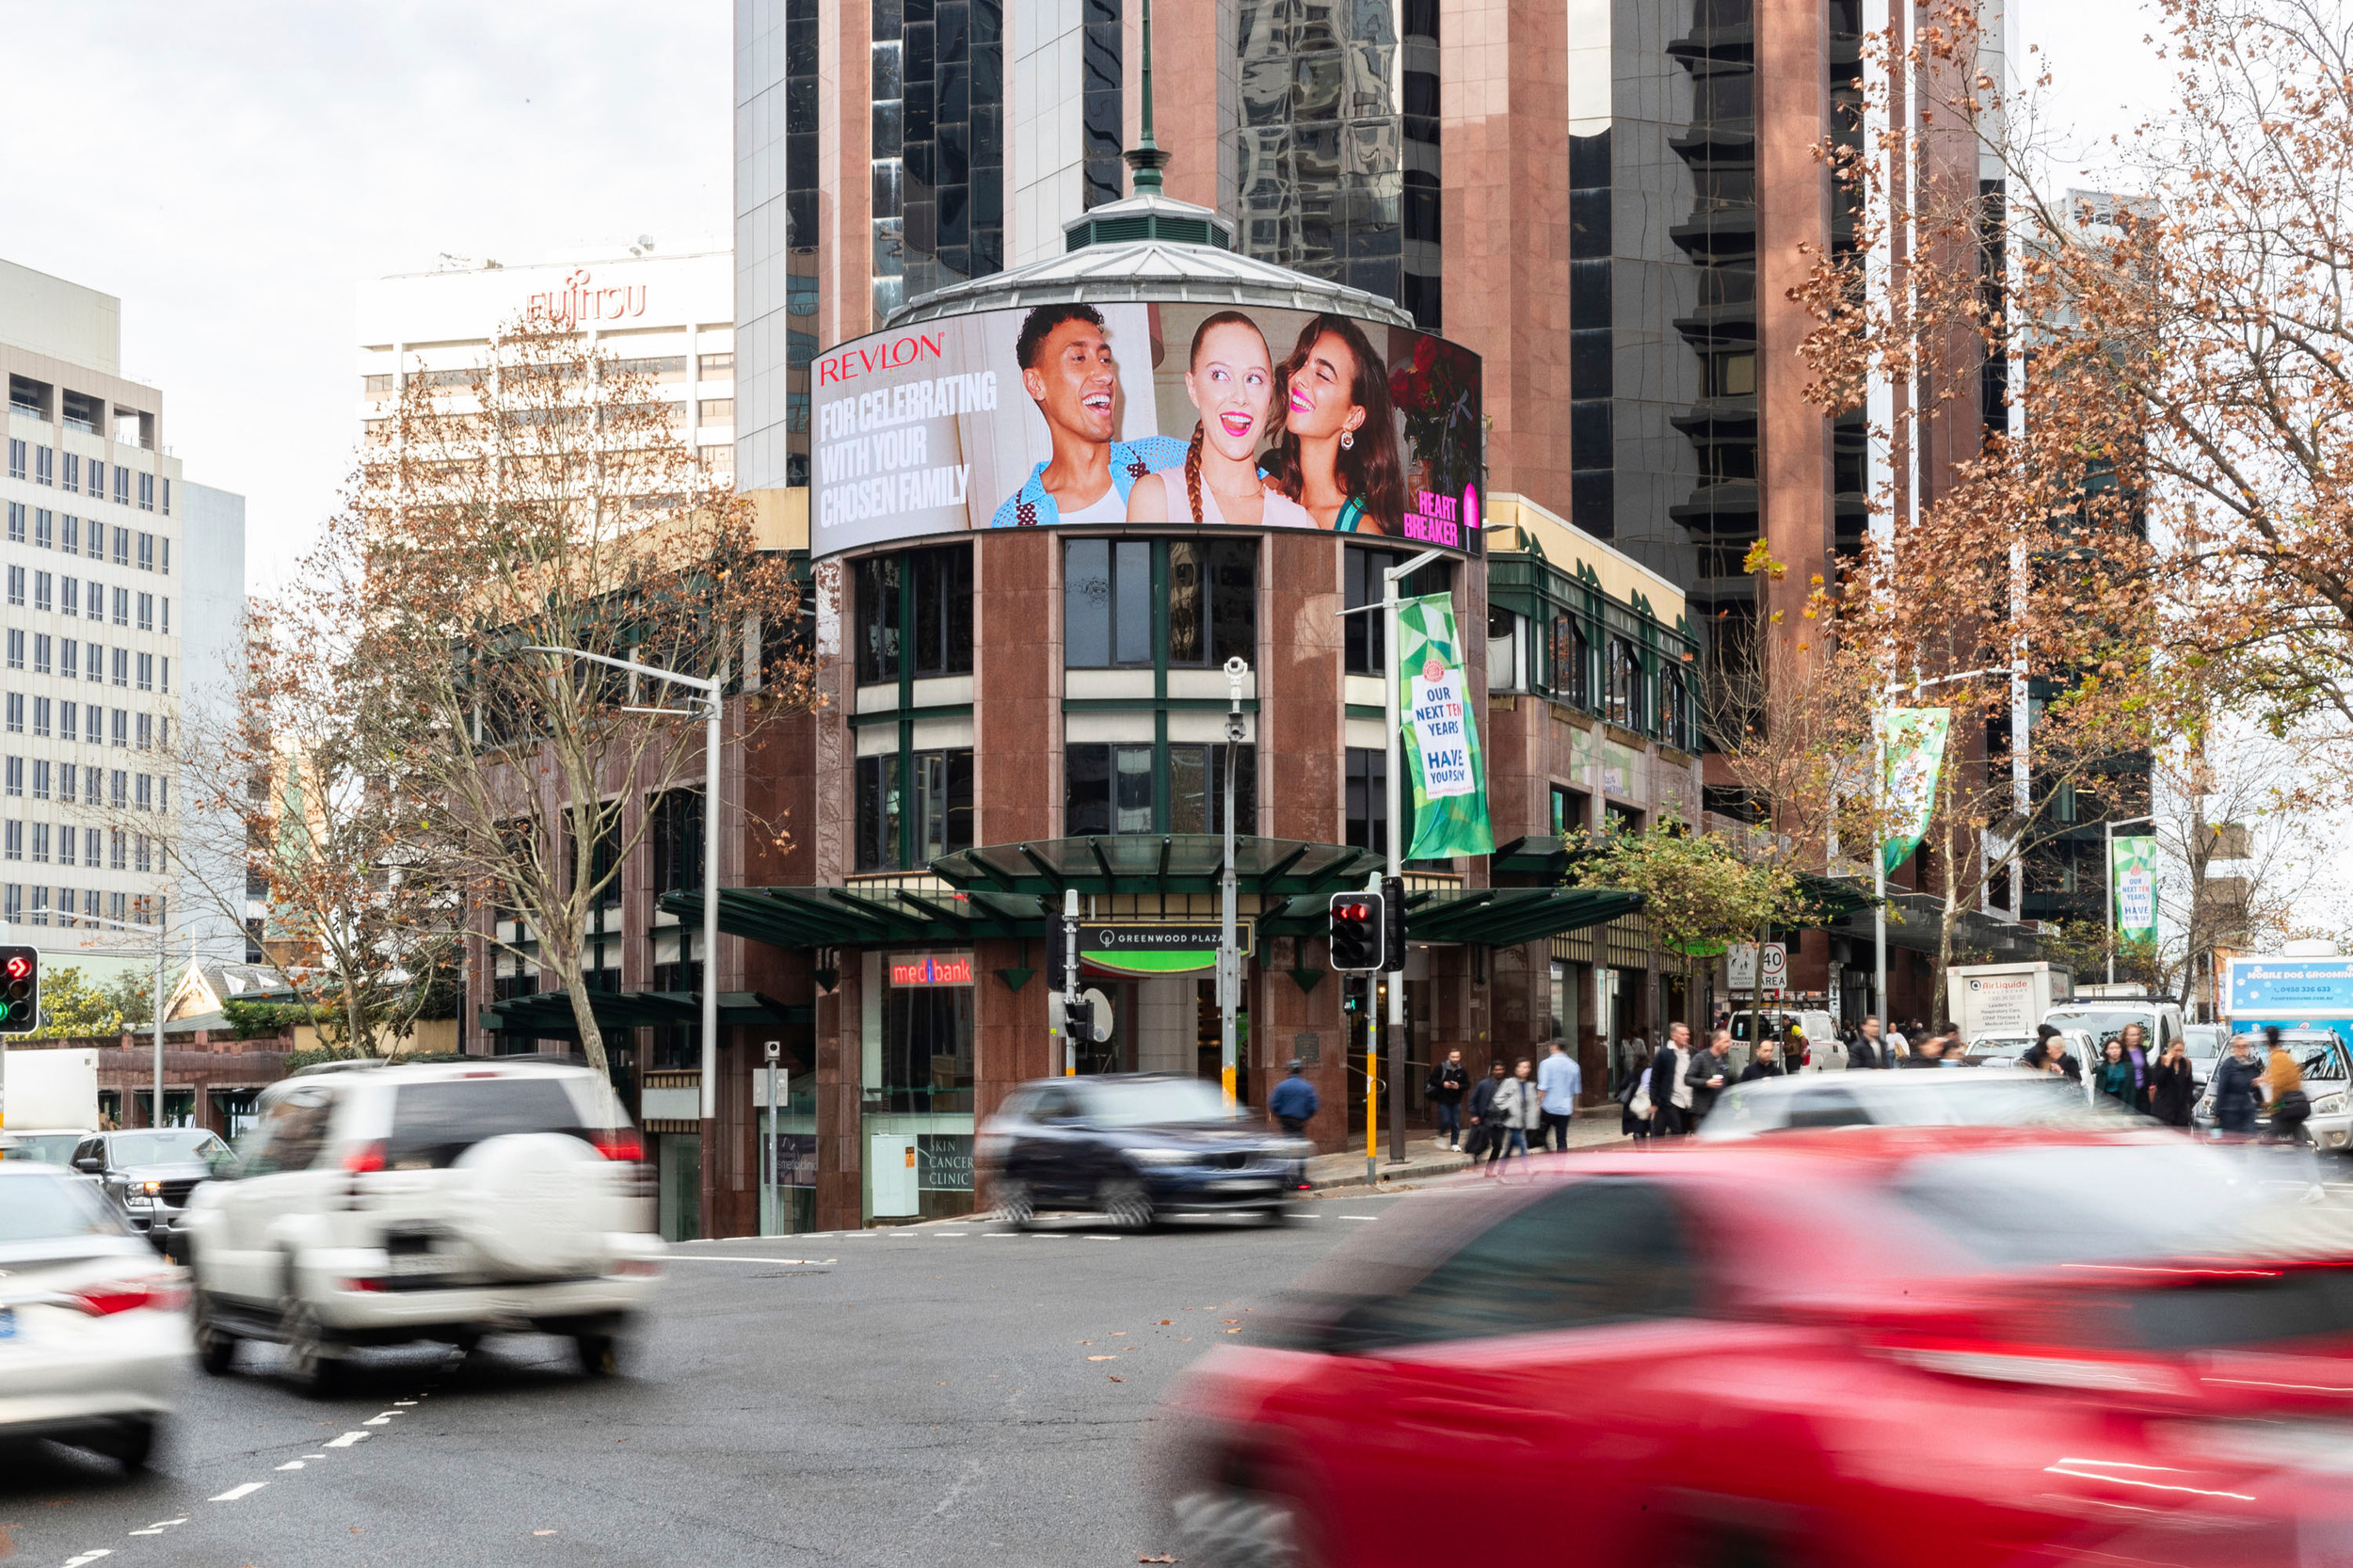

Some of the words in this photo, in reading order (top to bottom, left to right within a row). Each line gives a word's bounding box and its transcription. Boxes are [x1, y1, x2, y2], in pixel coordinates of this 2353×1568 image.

[526, 270, 647, 330] FUJITSU
[821, 333, 941, 387] REVLON
[821, 396, 856, 442] FOR
[859, 371, 997, 433] CELEBRATING
[821, 437, 870, 485] WITH
[872, 425, 927, 472] YOUR
[821, 474, 895, 528] CHOSEN
[900, 464, 970, 513] FAMILY
[1418, 489, 1457, 521] HEART
[1403, 512, 1458, 547] BREAKER
[1427, 687, 1450, 702] OUR
[1416, 705, 1444, 721] NEXT
[1446, 703, 1462, 717] TEN
[1428, 721, 1458, 736] YEARS
[1428, 749, 1464, 769] HAVE
[1431, 770, 1452, 784] YOUR
[2124, 906, 2149, 915] HAVE
[1764, 952, 1782, 966] 40
[893, 957, 972, 984] medibank
[2306, 970, 2353, 979] GROOMIN
[1983, 981, 1993, 989] Air
[1995, 981, 2027, 989] Liquide
[929, 1140, 955, 1152] SKIN
[776, 1160, 799, 1170] smetic
[929, 1156, 973, 1168] CANCER
[929, 1173, 968, 1185] CLINIC
